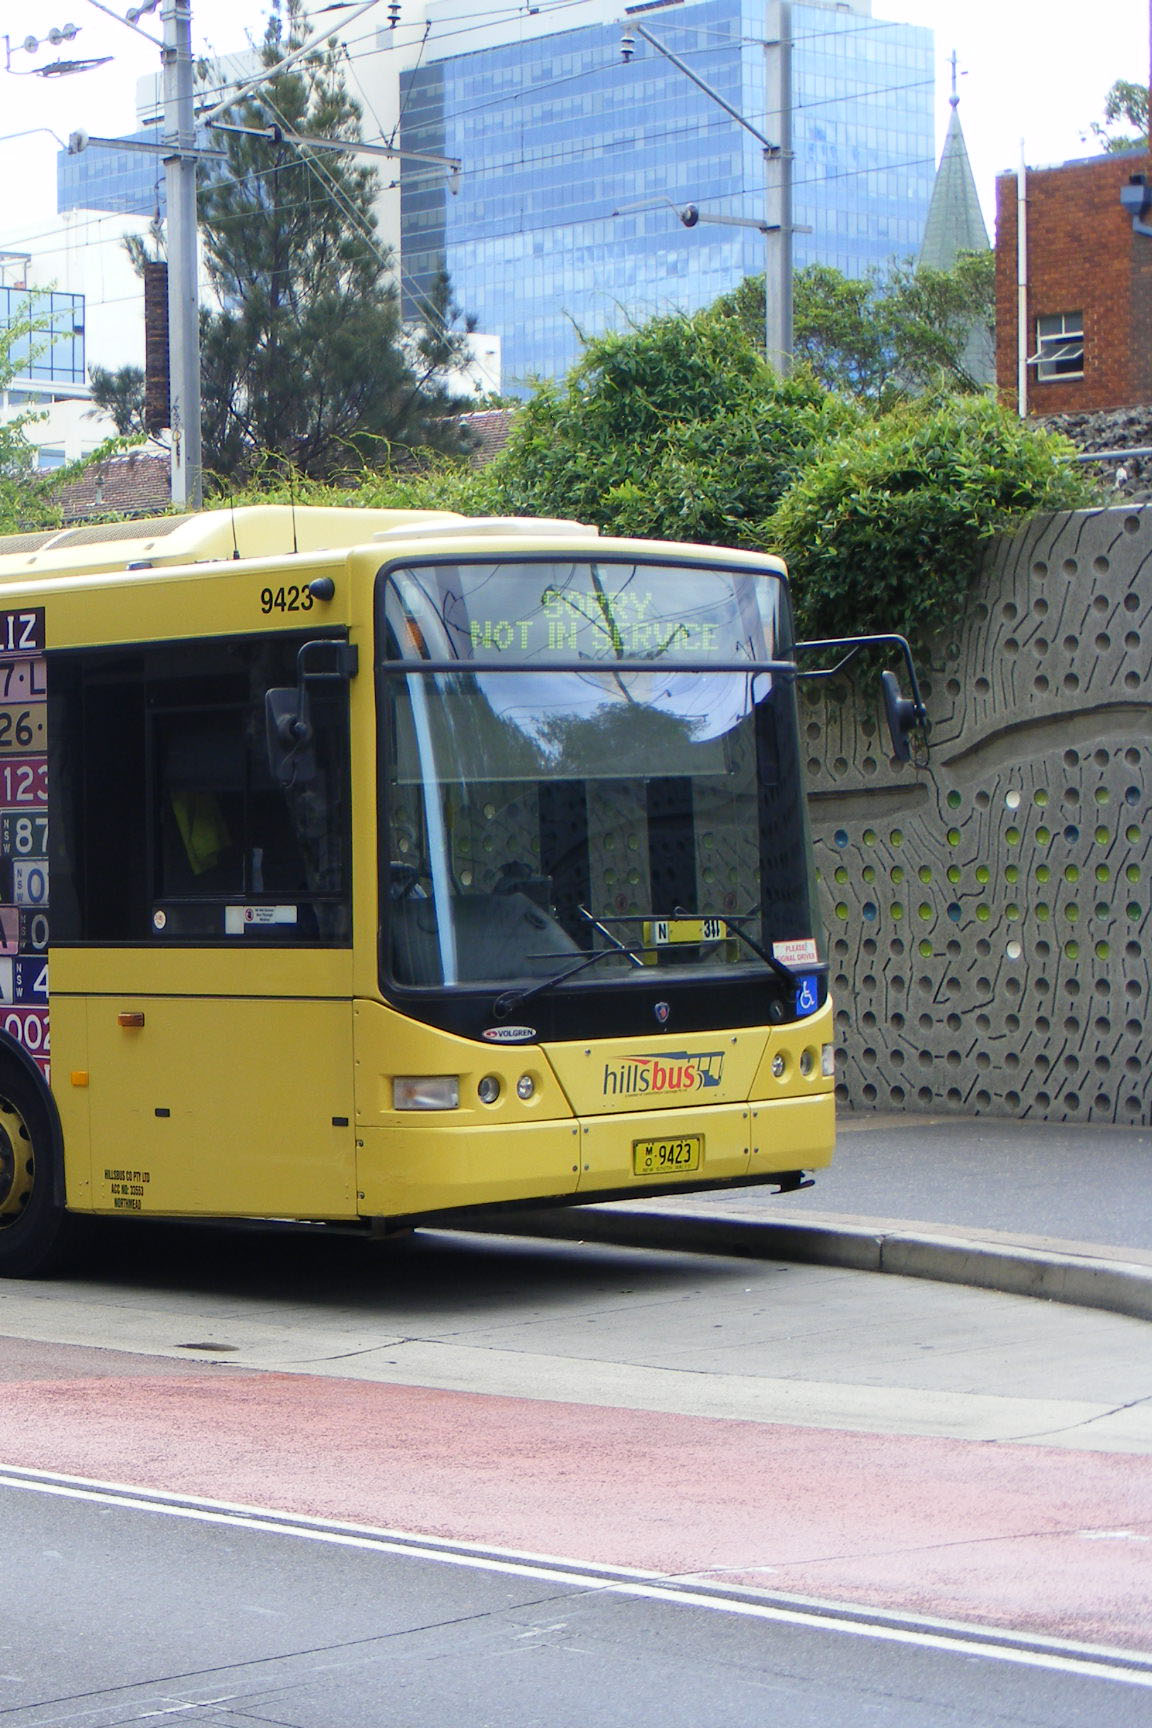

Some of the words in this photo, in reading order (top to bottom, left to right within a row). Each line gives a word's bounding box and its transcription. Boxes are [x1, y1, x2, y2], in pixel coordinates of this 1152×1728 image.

[261, 584, 314, 614] 9423
[544, 591, 652, 619] SORRY
[470, 621, 534, 649] NOT
[548, 622, 577, 649] IN
[592, 622, 719, 650] SERVICE
[4, 819, 12, 854] NSW
[657, 922, 667, 939] N
[15, 963, 23, 998] NSW
[498, 1029, 534, 1038] VOLGREN
[603, 1060, 696, 1095] hillsbus
[658, 1143, 692, 1166] 9423
[104, 1169, 125, 1180] HILLSBUS
[126, 1170, 133, 1181] CO
[133, 1171, 142, 1182] PTY
[142, 1171, 151, 1183] LTD
[111, 1183, 120, 1194] ACC
